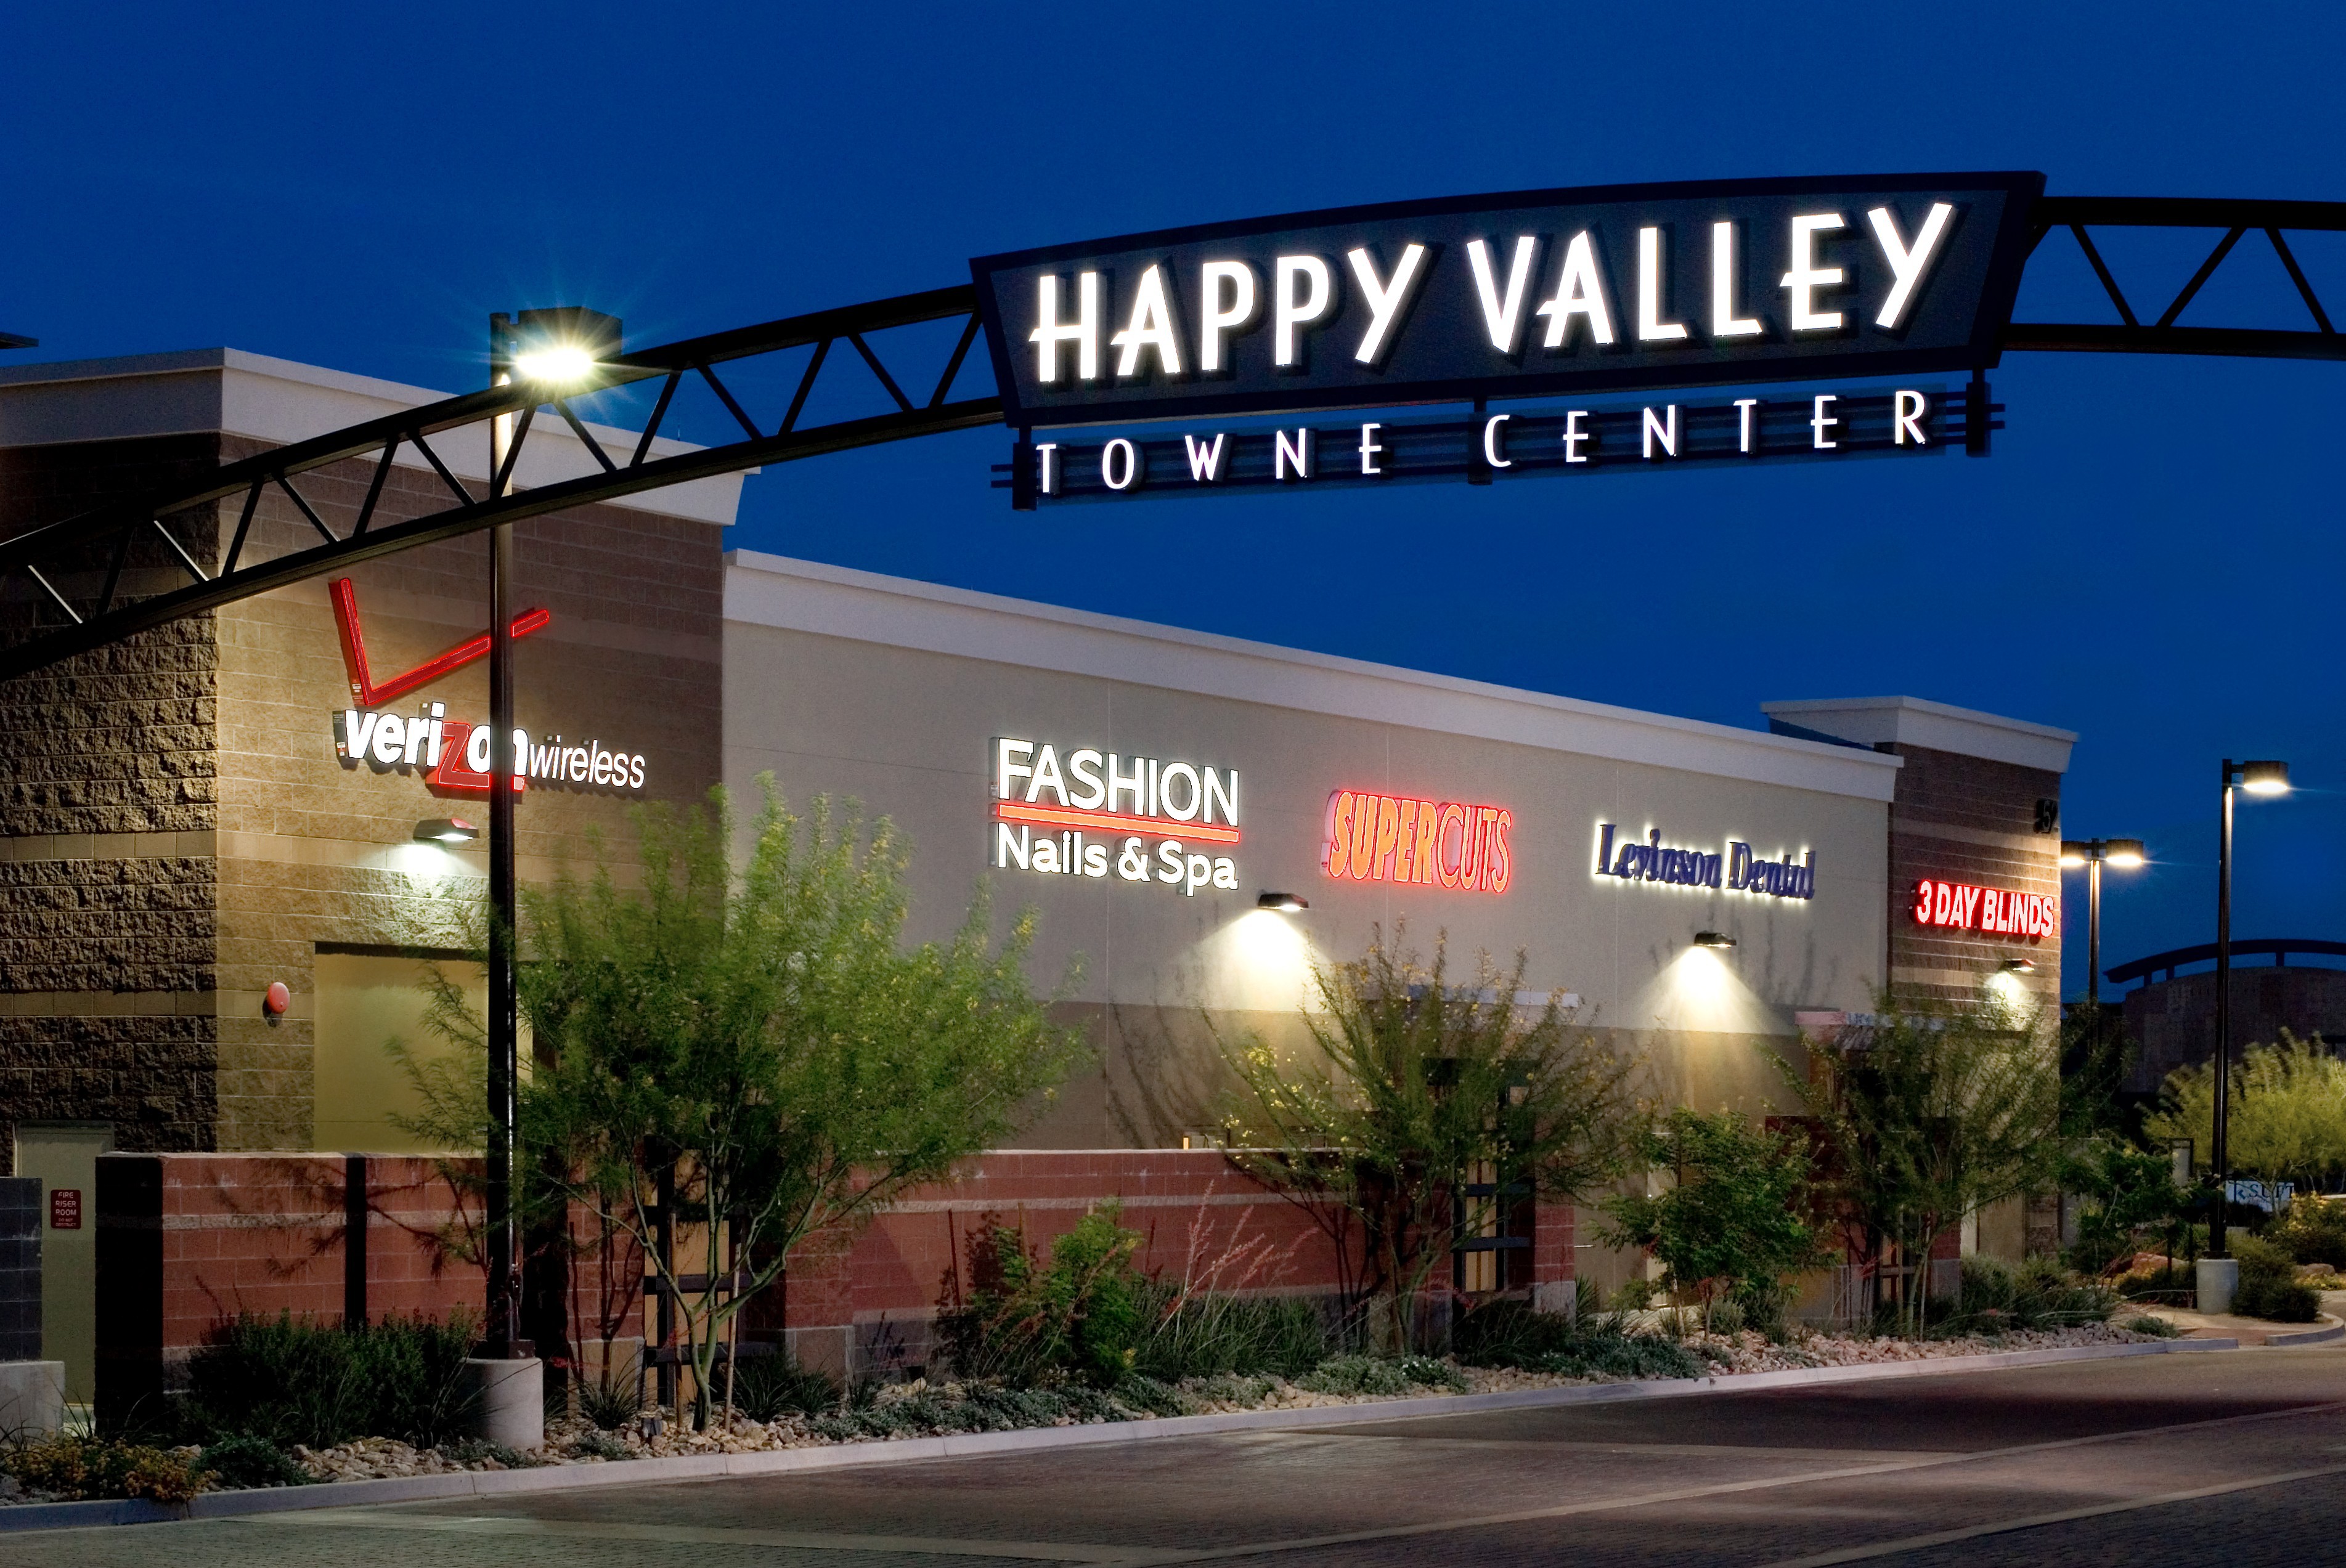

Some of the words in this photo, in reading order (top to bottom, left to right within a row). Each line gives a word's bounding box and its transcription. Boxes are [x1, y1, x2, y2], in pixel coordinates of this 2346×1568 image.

[1028, 244, 1425, 382] HAPPY
[1467, 203, 1952, 353] VALLEY
[1035, 423, 1382, 494] TOWNE
[1484, 390, 1926, 468] CENTER
[529, 734, 646, 789] wireless
[997, 737, 1239, 827] FASHION
[997, 822, 1109, 878] Nails
[1117, 837, 1151, 882] &
[1157, 840, 1239, 897] Spa
[1328, 791, 1512, 893] SUPERCUTS
[1725, 841, 1817, 901] Dental
[1916, 880, 1933, 924] 3
[1934, 882, 1982, 928] DAY
[1982, 889, 2055, 938] BLINDS
